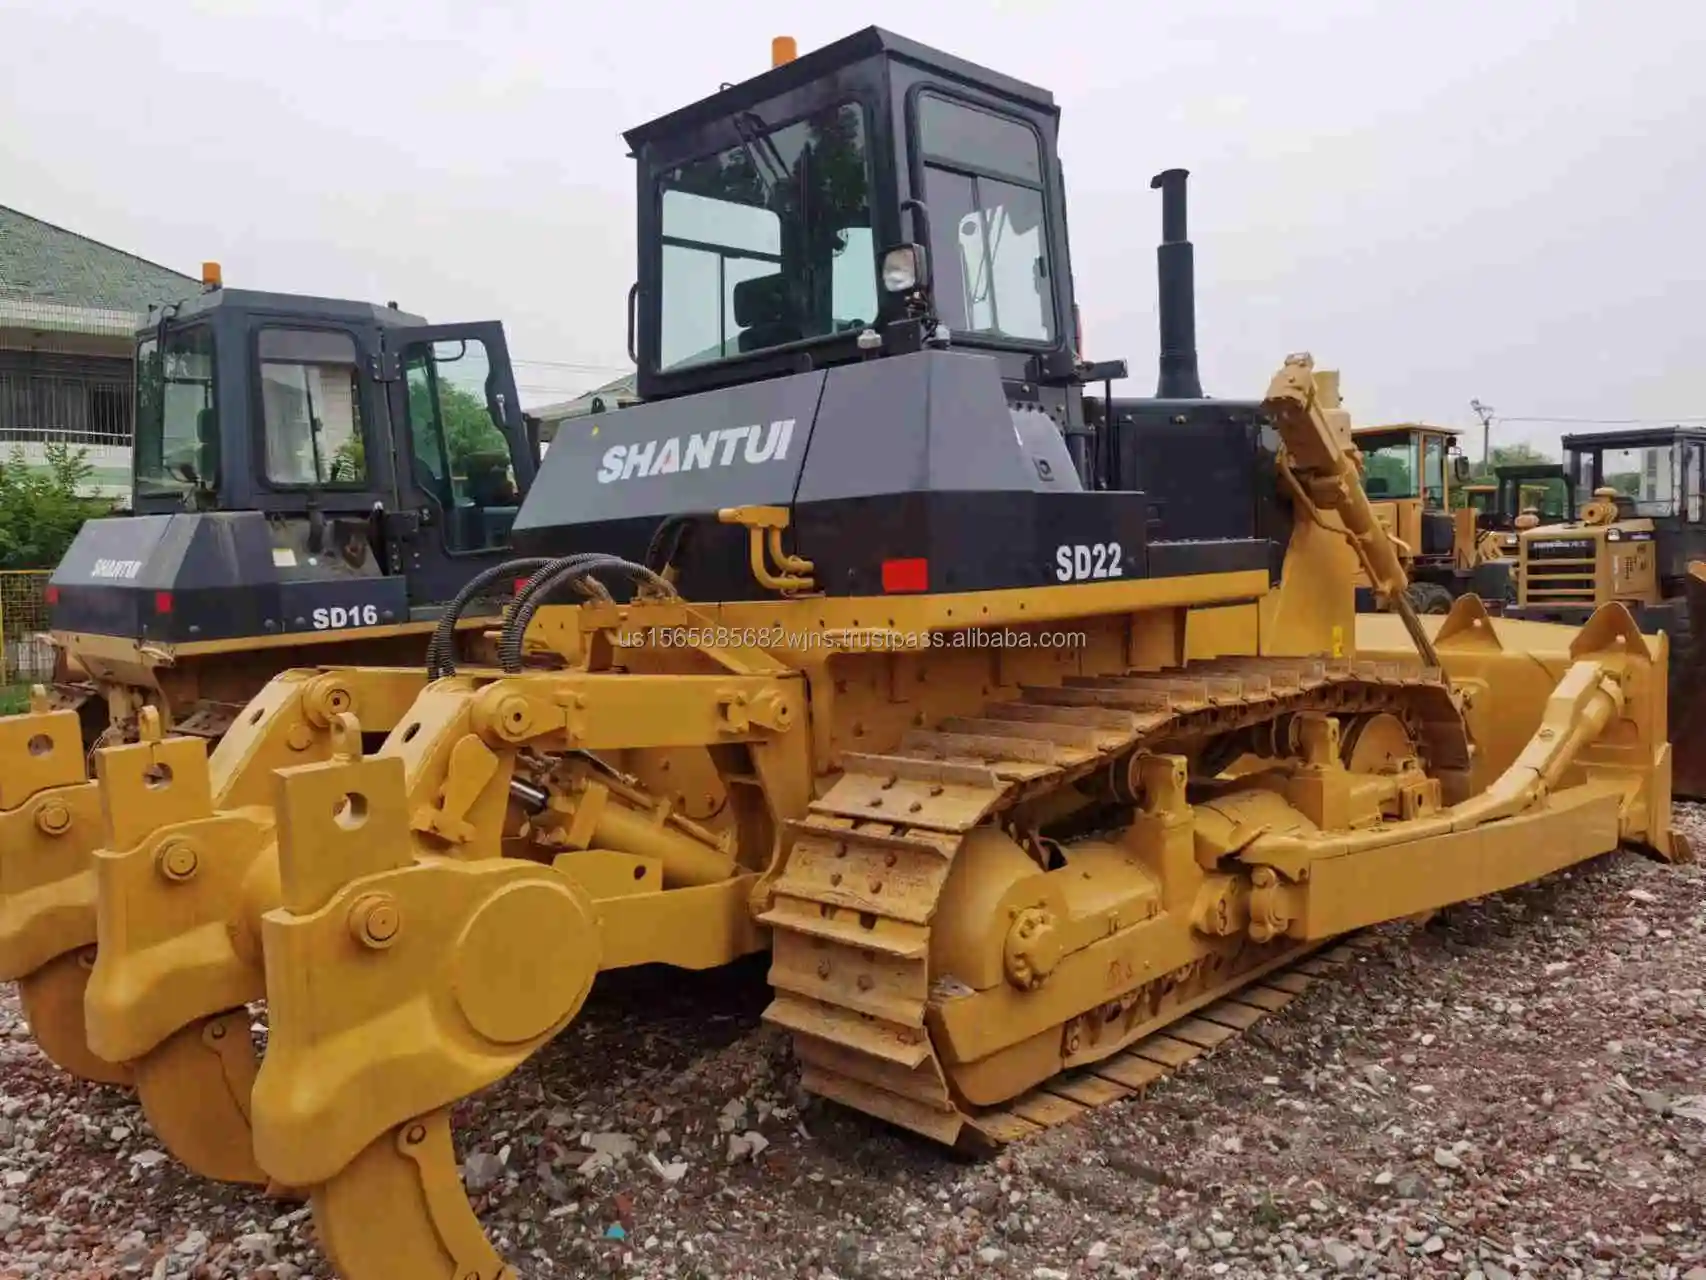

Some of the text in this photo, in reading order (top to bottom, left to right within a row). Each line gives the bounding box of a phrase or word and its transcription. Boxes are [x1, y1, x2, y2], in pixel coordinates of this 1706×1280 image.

[597, 419, 795, 483] SHANTUI
[1056, 542, 1123, 581] SD22
[312, 604, 378, 629] SD16
